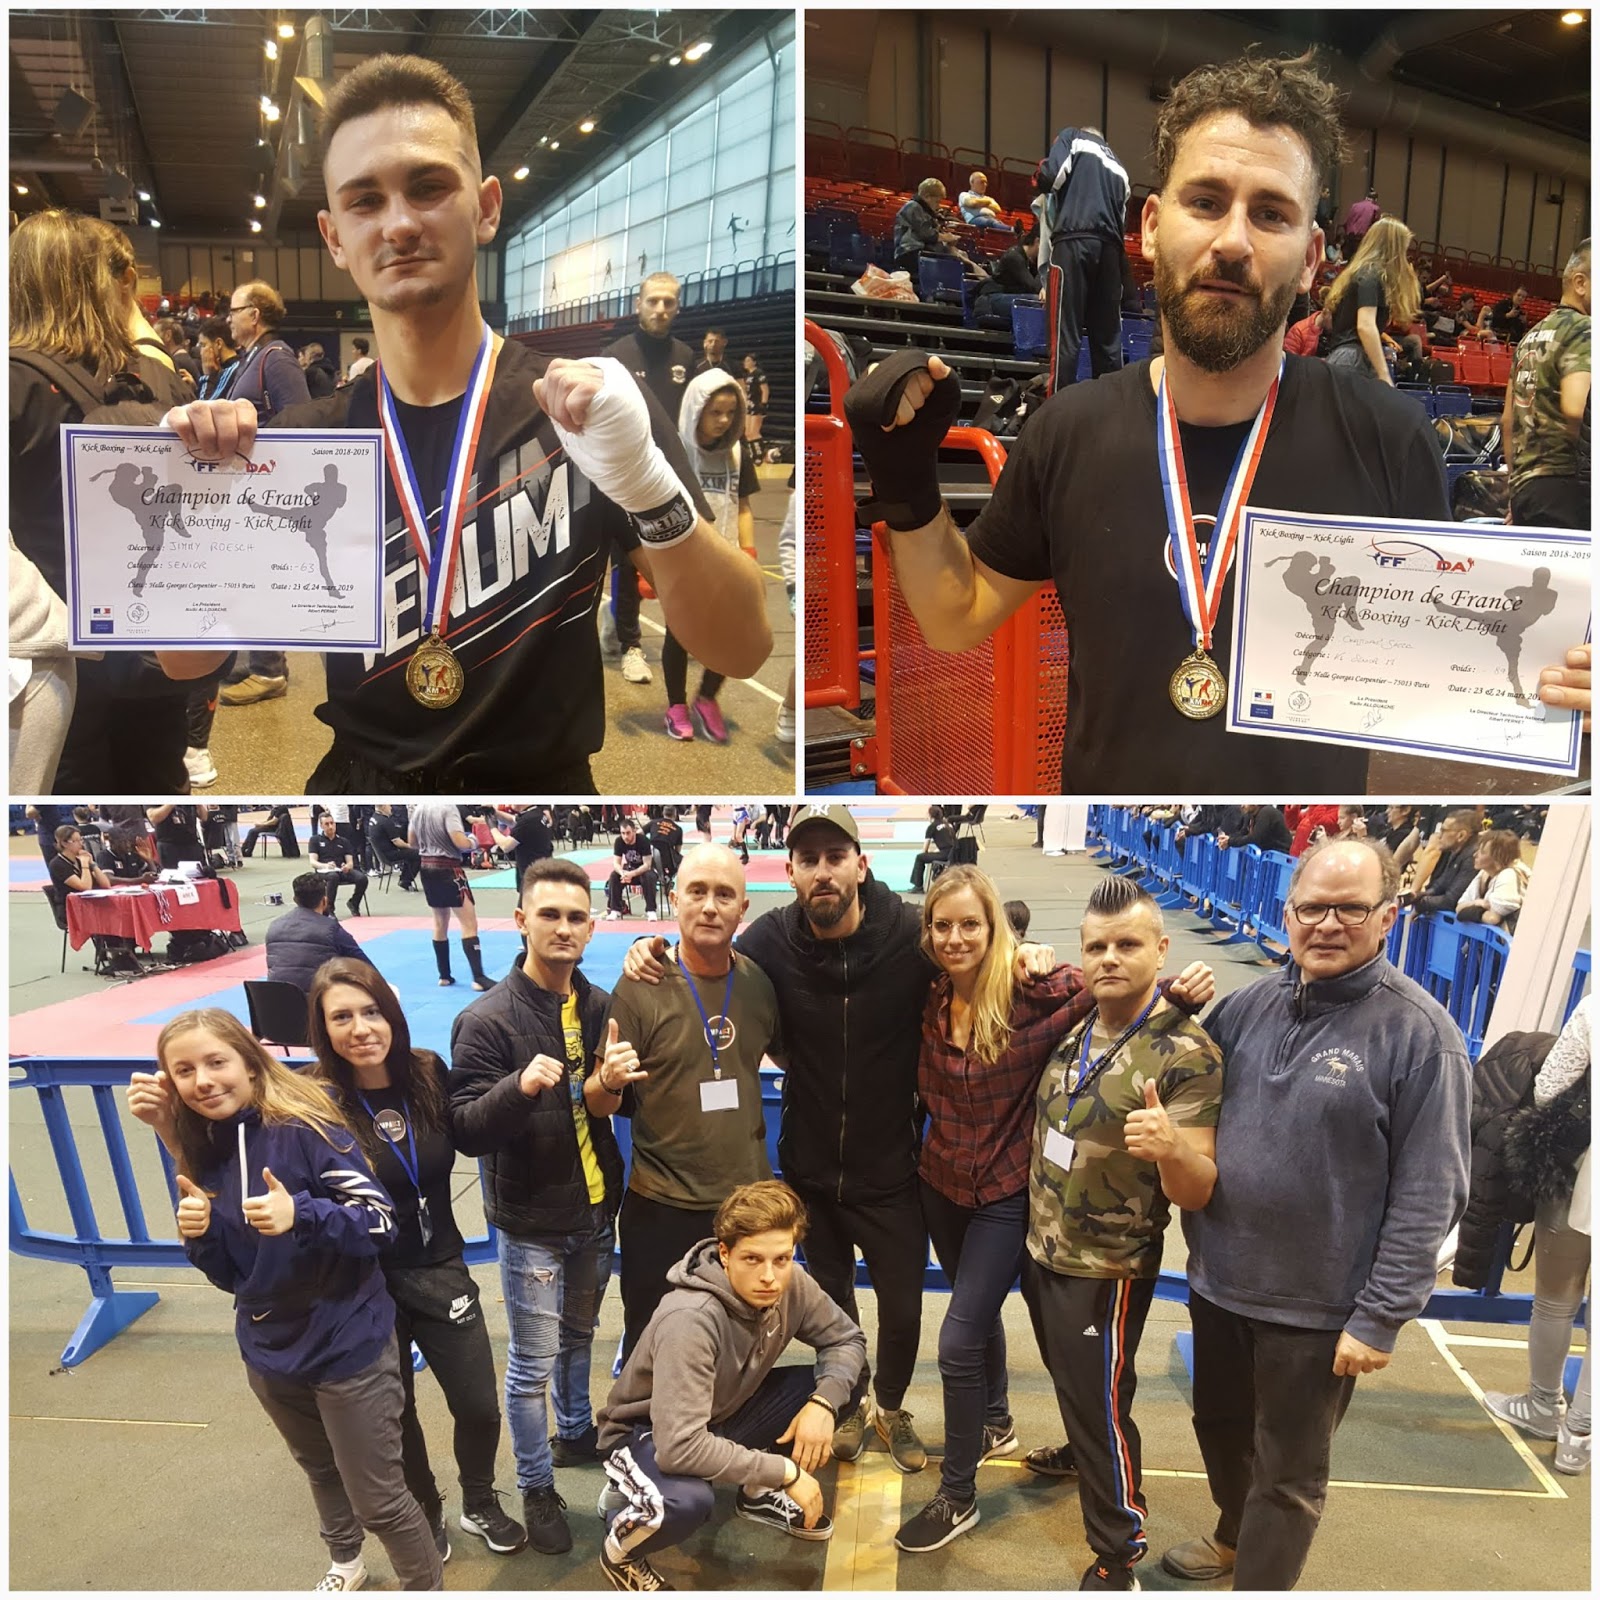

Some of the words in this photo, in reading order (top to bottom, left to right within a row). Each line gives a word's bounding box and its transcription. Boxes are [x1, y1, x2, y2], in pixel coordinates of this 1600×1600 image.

[81, 443, 99, 453] Kick
[99, 444, 125, 453] Boxing
[133, 445, 152, 453] Kick
[151, 445, 172, 455] Light
[312, 448, 333, 456] Saison
[335, 448, 369, 456] 2018-2019
[141, 486, 231, 510] Champion
[236, 487, 256, 505] de
[261, 489, 320, 506] France
[149, 515, 186, 530] Kick
[184, 515, 231, 531] Boxing
[243, 516, 277, 531] Kick
[277, 515, 312, 533] Light
[1259, 527, 1279, 538] Kick
[1278, 529, 1304, 541] Boxing
[1313, 532, 1333, 543] Kick
[1332, 534, 1355, 545] Light
[210, 543, 255, 552] ROESCH
[1520, 548, 1547, 557] Saison
[1549, 549, 1591, 559] 2018-2019
[167, 561, 207, 569] SENIOR
[311, 583, 320, 591] 24
[338, 584, 354, 592] 2019
[1315, 577, 1415, 604] Champion
[1420, 585, 1444, 604] de
[1451, 589, 1523, 612] France
[1321, 605, 1358, 623] Kick
[1358, 608, 1410, 628] Boxing
[1425, 614, 1464, 632] Kick
[1464, 617, 1508, 636] Light
[1450, 664, 1472, 673] Poids
[1331, 673, 1354, 682] Georges
[1355, 675, 1387, 685] Carpentier
[1393, 679, 1413, 687] 75013
[1413, 681, 1430, 689] Paris
[1448, 684, 1467, 693] Date
[1473, 687, 1483, 695] 23
[1495, 689, 1505, 697] 24
[1507, 691, 1526, 699] mars
[1311, 1048, 1340, 1062] GRAND
[1341, 1049, 1364, 1072] MARAIS
[452, 1294, 469, 1310] NIKE
